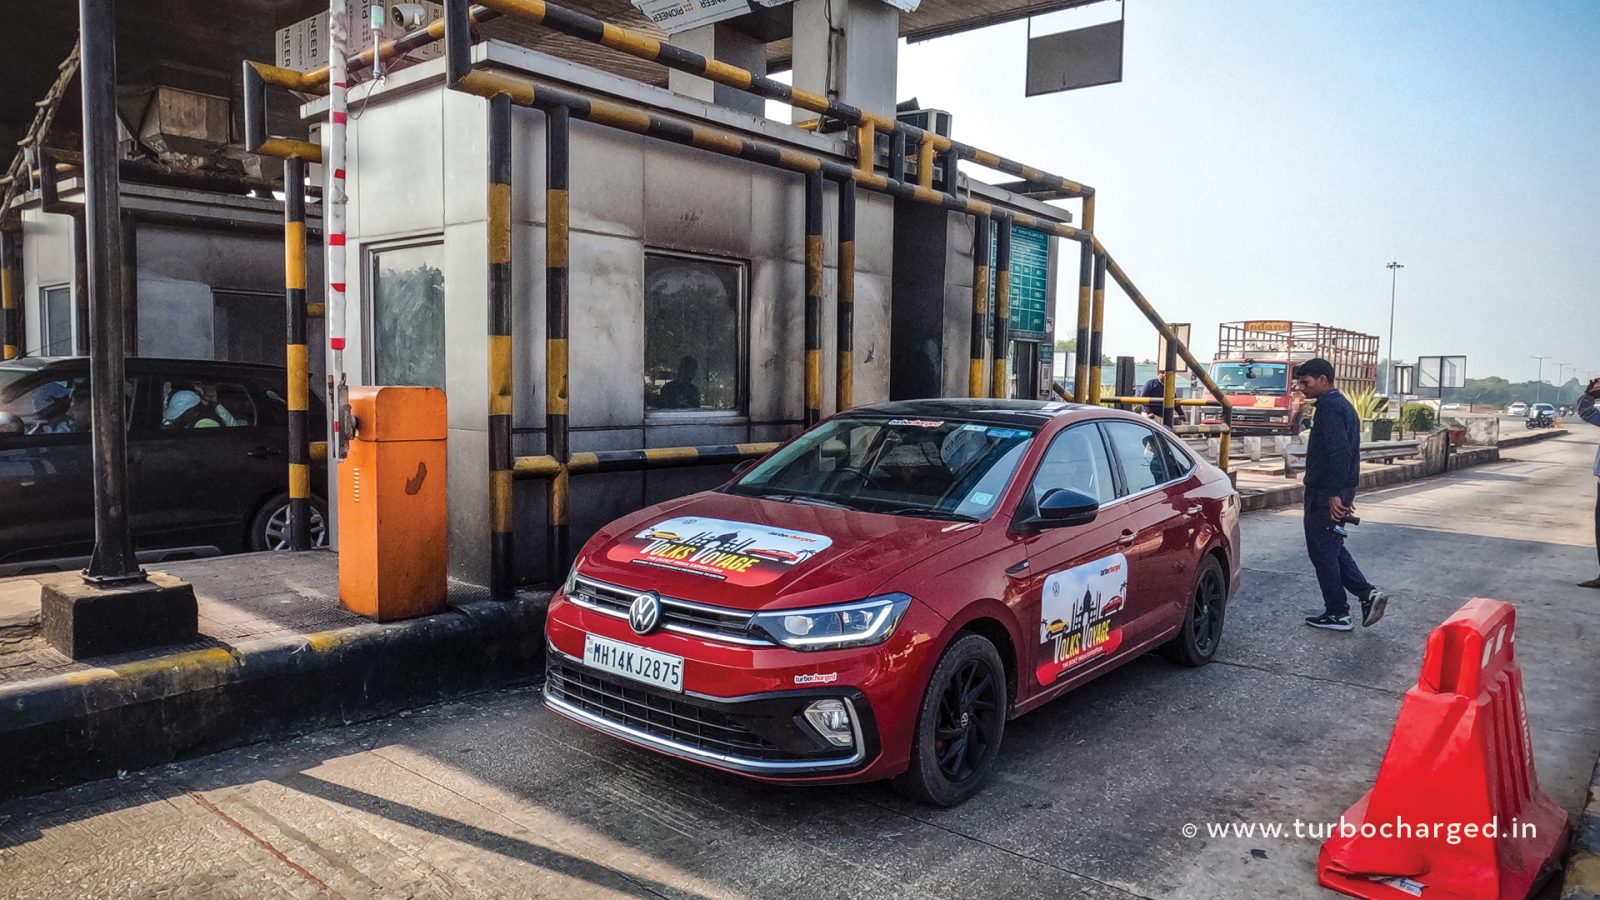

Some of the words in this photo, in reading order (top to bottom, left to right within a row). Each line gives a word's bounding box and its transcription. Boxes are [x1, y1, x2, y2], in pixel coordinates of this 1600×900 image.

[652, 4, 685, 23] PIONEER
[640, 539, 697, 560] VOLKS
[689, 546, 761, 573] VOYAGE
[1053, 632, 1081, 665] VOLKS
[1082, 620, 1110, 651] VOYAGE
[593, 642, 680, 685] MH14KJ2875
[795, 673, 837, 683] turbocharged
